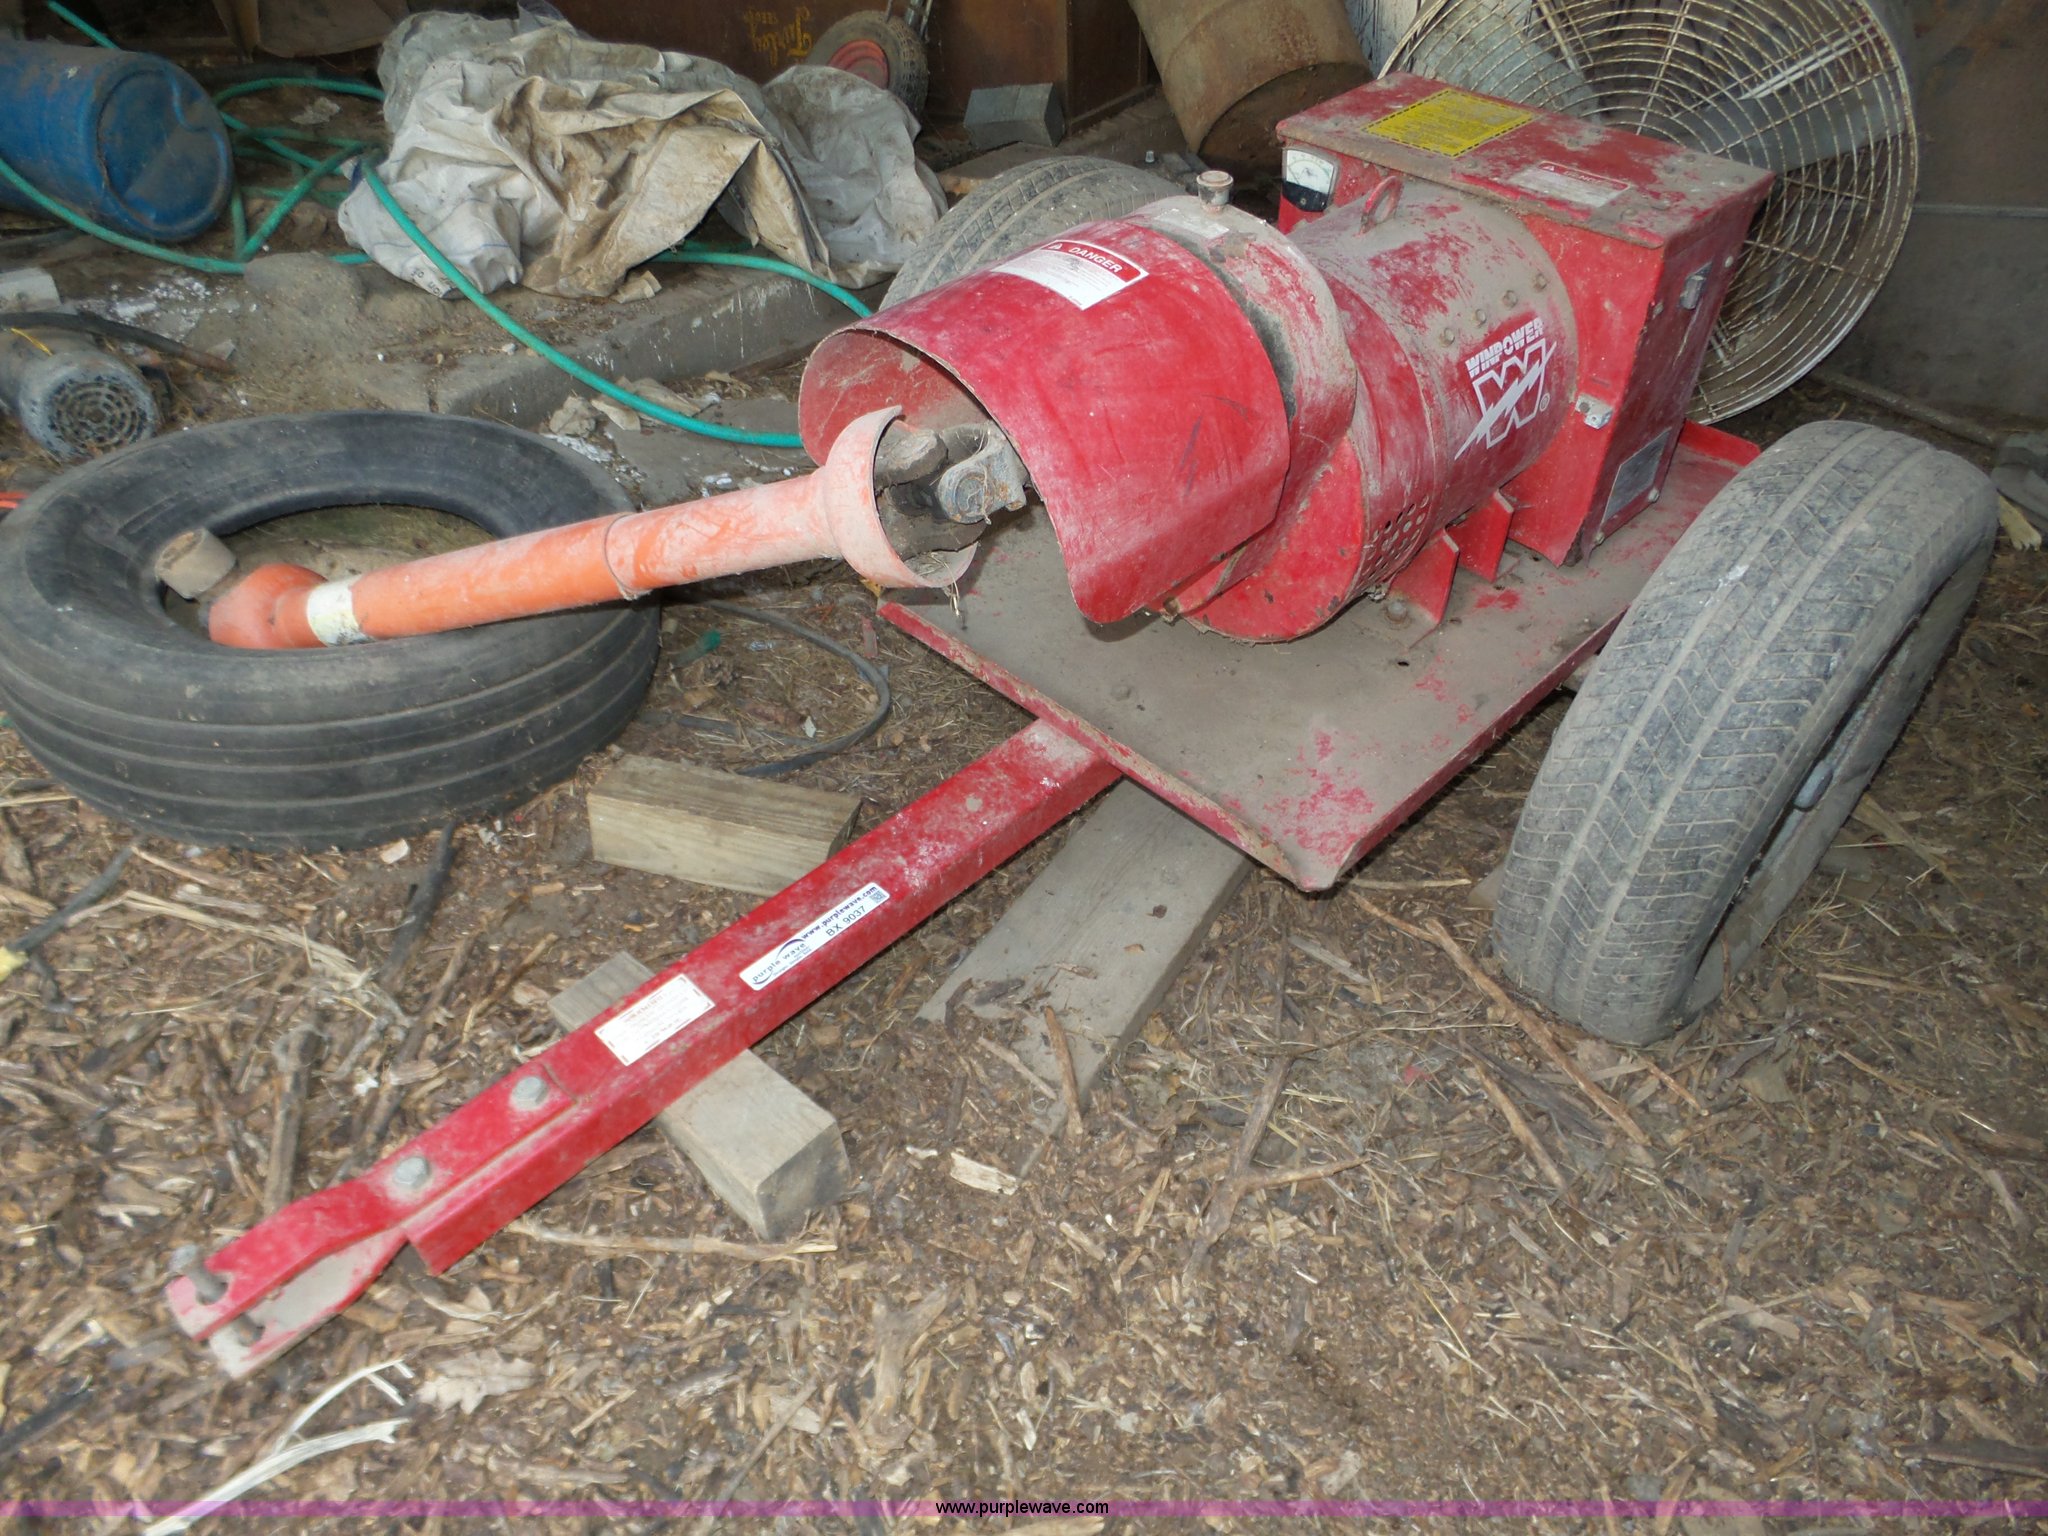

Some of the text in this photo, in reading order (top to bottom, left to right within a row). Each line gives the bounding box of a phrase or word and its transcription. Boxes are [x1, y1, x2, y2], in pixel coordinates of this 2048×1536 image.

[1068, 247, 1123, 273] DANGER
[1465, 317, 1544, 378] WINPOWER
[801, 886, 877, 939] www.purplewave.com
[826, 905, 867, 937] BX 9037
[752, 960, 781, 984] purple
[782, 943, 805, 960] wave
